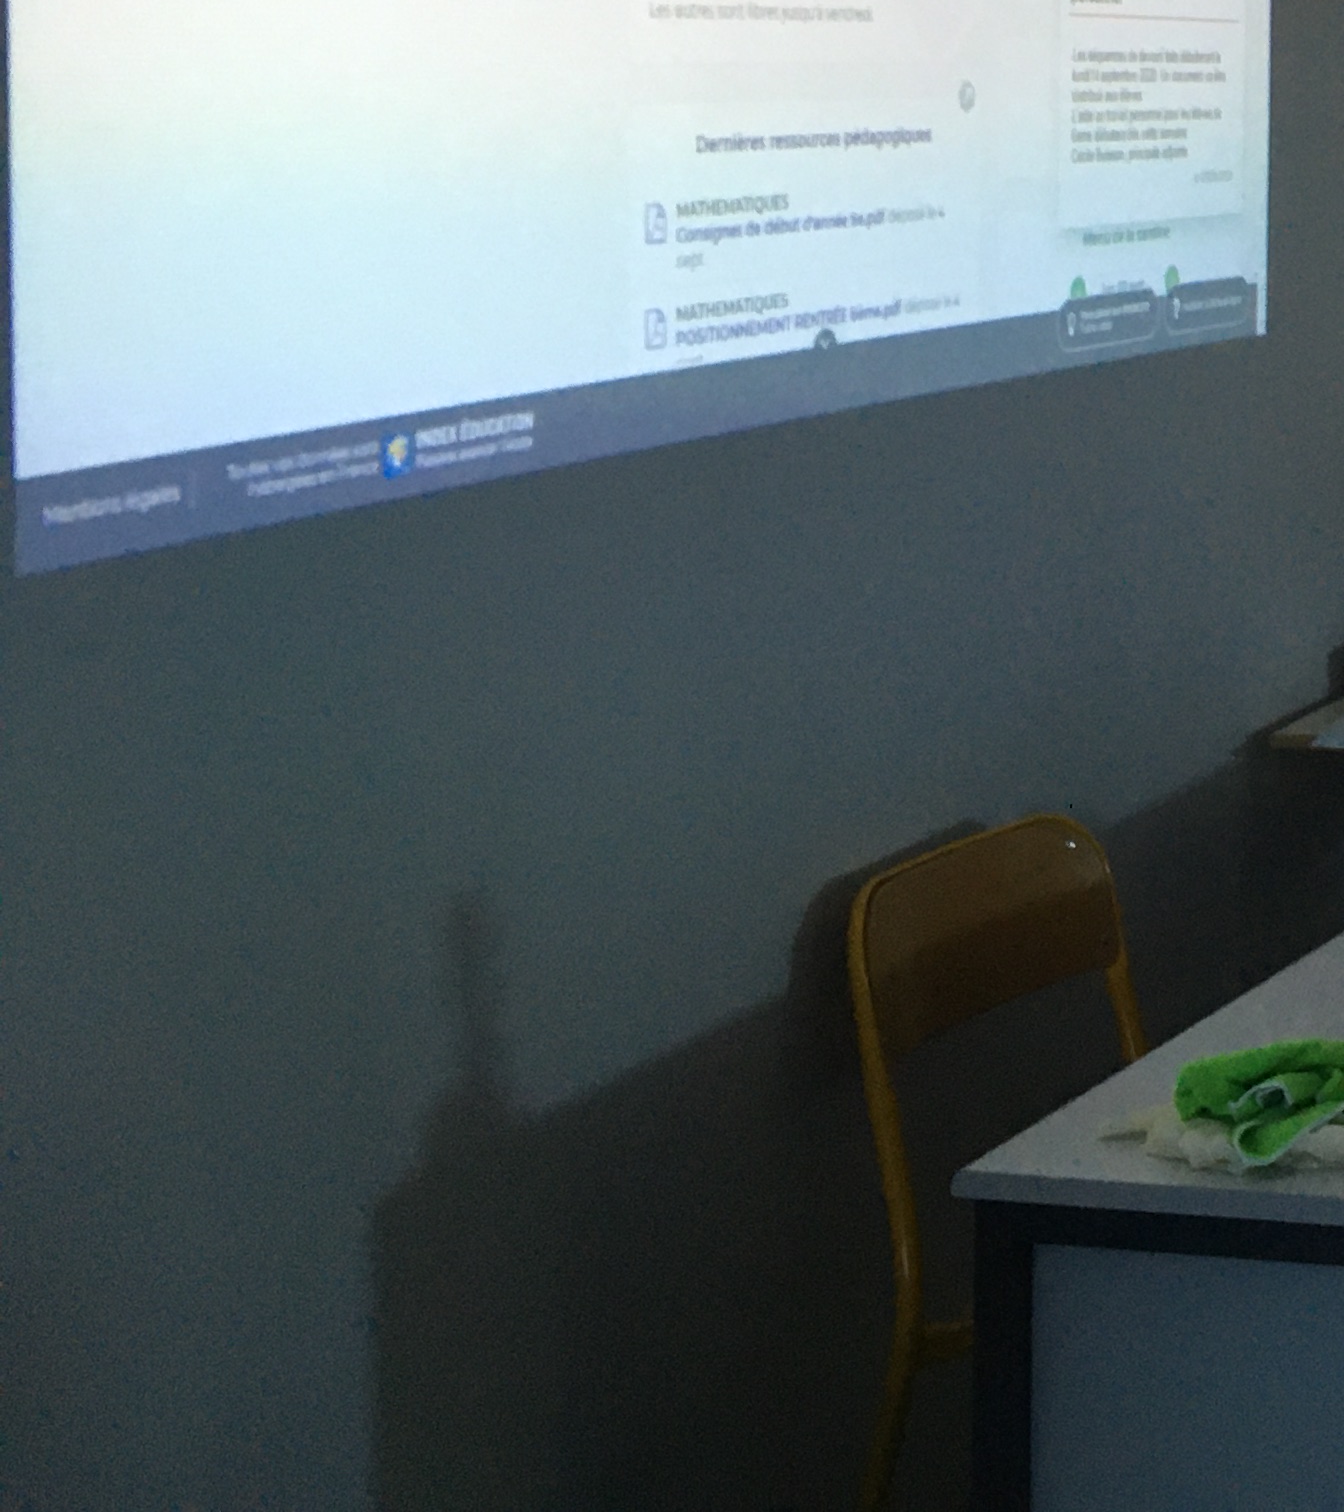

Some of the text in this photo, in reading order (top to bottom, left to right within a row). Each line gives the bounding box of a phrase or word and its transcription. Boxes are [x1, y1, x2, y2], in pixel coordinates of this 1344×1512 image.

[695, 124, 932, 157] Dernières ressources pédagogiques
[675, 195, 789, 220] MATHEMATIQUES
[675, 222, 742, 246] Consignes
[745, 220, 761, 240] de
[764, 217, 800, 238] début
[675, 292, 788, 324] MATHEMATIQUES
[675, 314, 791, 349] POSITIONNEMENT
